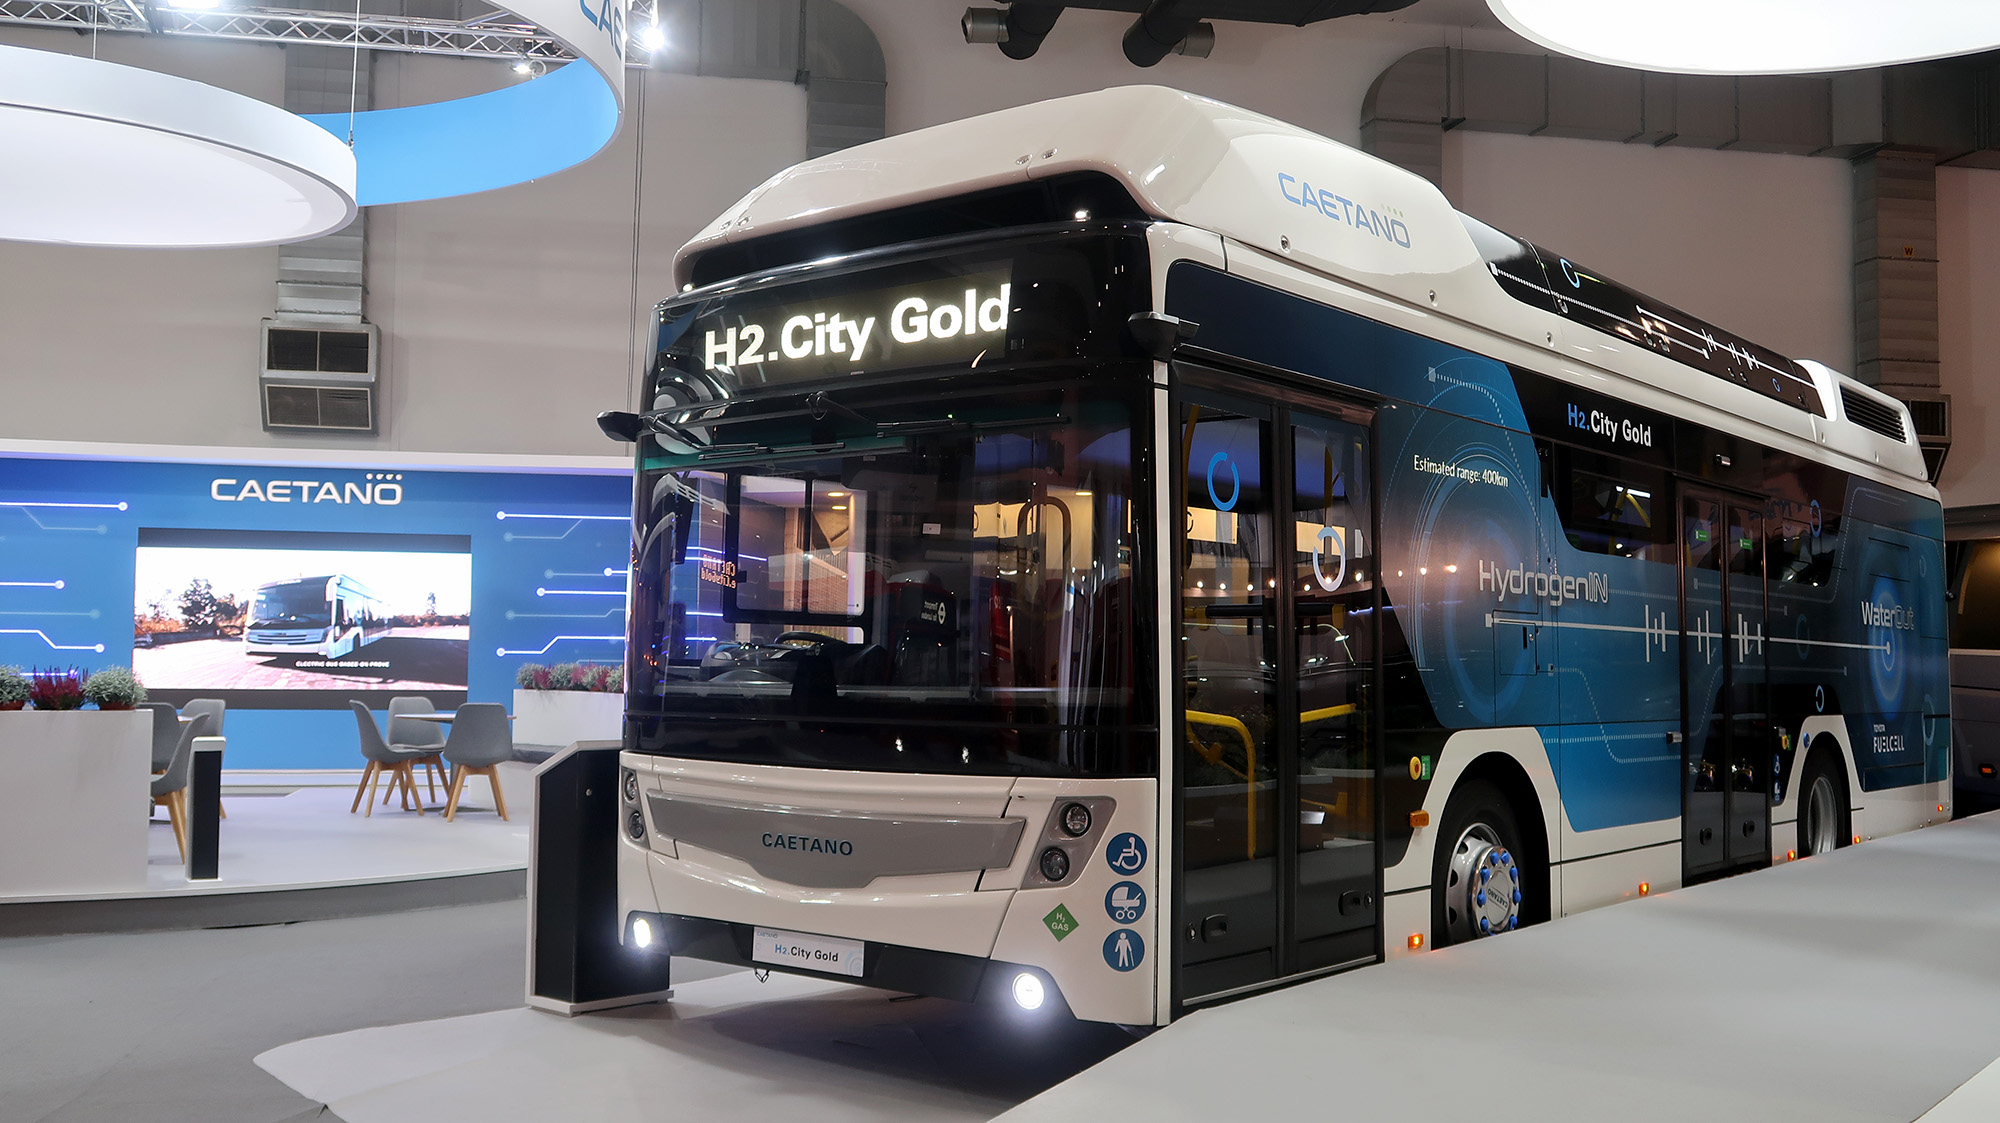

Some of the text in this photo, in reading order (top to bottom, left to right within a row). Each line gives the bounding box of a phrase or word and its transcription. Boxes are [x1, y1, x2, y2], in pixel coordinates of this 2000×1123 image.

[1278, 172, 1411, 249] CAETANO
[705, 283, 1012, 371] H2.City Gold
[1567, 403, 1652, 447] H2.City Gold
[1414, 454, 1509, 487] Estimated range: 400km
[211, 473, 403, 506] CAETANO
[1479, 559, 1609, 607] HydrogenIN
[1861, 600, 1915, 630] WaterOut
[295, 660, 325, 668] ELECTRIC
[762, 832, 853, 856] CAETANO
[1051, 922, 1069, 932] GAS
[775, 944, 839, 962] H2.City Gold
